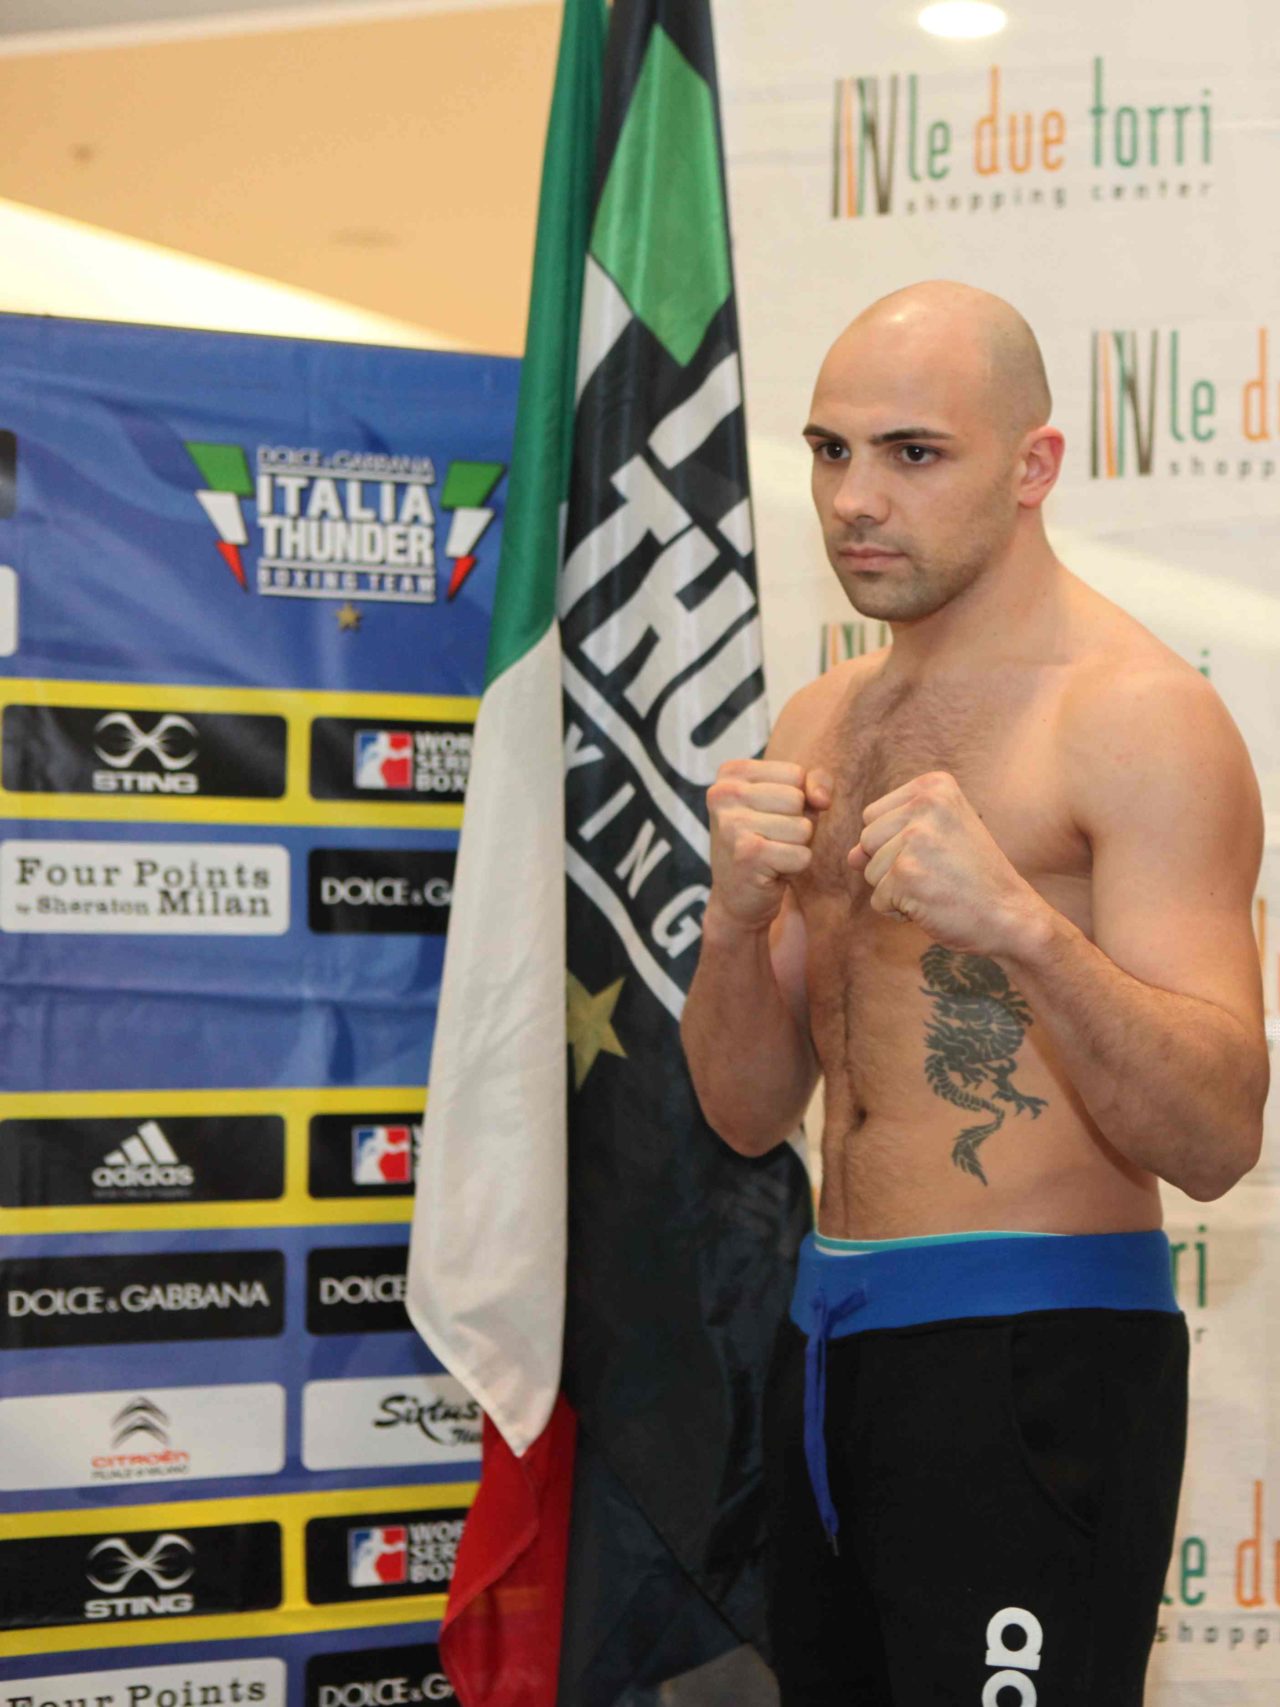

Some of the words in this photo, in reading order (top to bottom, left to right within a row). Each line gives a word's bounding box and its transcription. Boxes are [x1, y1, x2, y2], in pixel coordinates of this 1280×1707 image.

[908, 74, 951, 182] le
[975, 64, 1065, 176] due
[1089, 57, 1211, 169] torri
[906, 188, 1065, 214] shopping
[1092, 181, 1210, 200] center
[1169, 330, 1216, 443] le
[258, 474, 434, 526] ITALIA
[258, 517, 434, 569] THUNDER
[258, 569, 358, 592] BOXING
[369, 574, 435, 596] TEAM
[414, 732, 473, 756] WOR
[93, 771, 198, 793] STING
[415, 774, 469, 792] BOX
[16, 858, 120, 886] Four
[134, 860, 270, 889] Points
[37, 896, 149, 915] Sheraton
[158, 890, 271, 917] Milan
[321, 877, 408, 905] DOLCE
[92, 1162, 194, 1188] adidas
[8, 1287, 103, 1317] DOLCE
[121, 1281, 270, 1312] GABBANA
[408, 1520, 464, 1544] WOR
[85, 1593, 194, 1619] STING
[126, 1678, 266, 1707] Points
[318, 1677, 408, 1707] DOLCE
